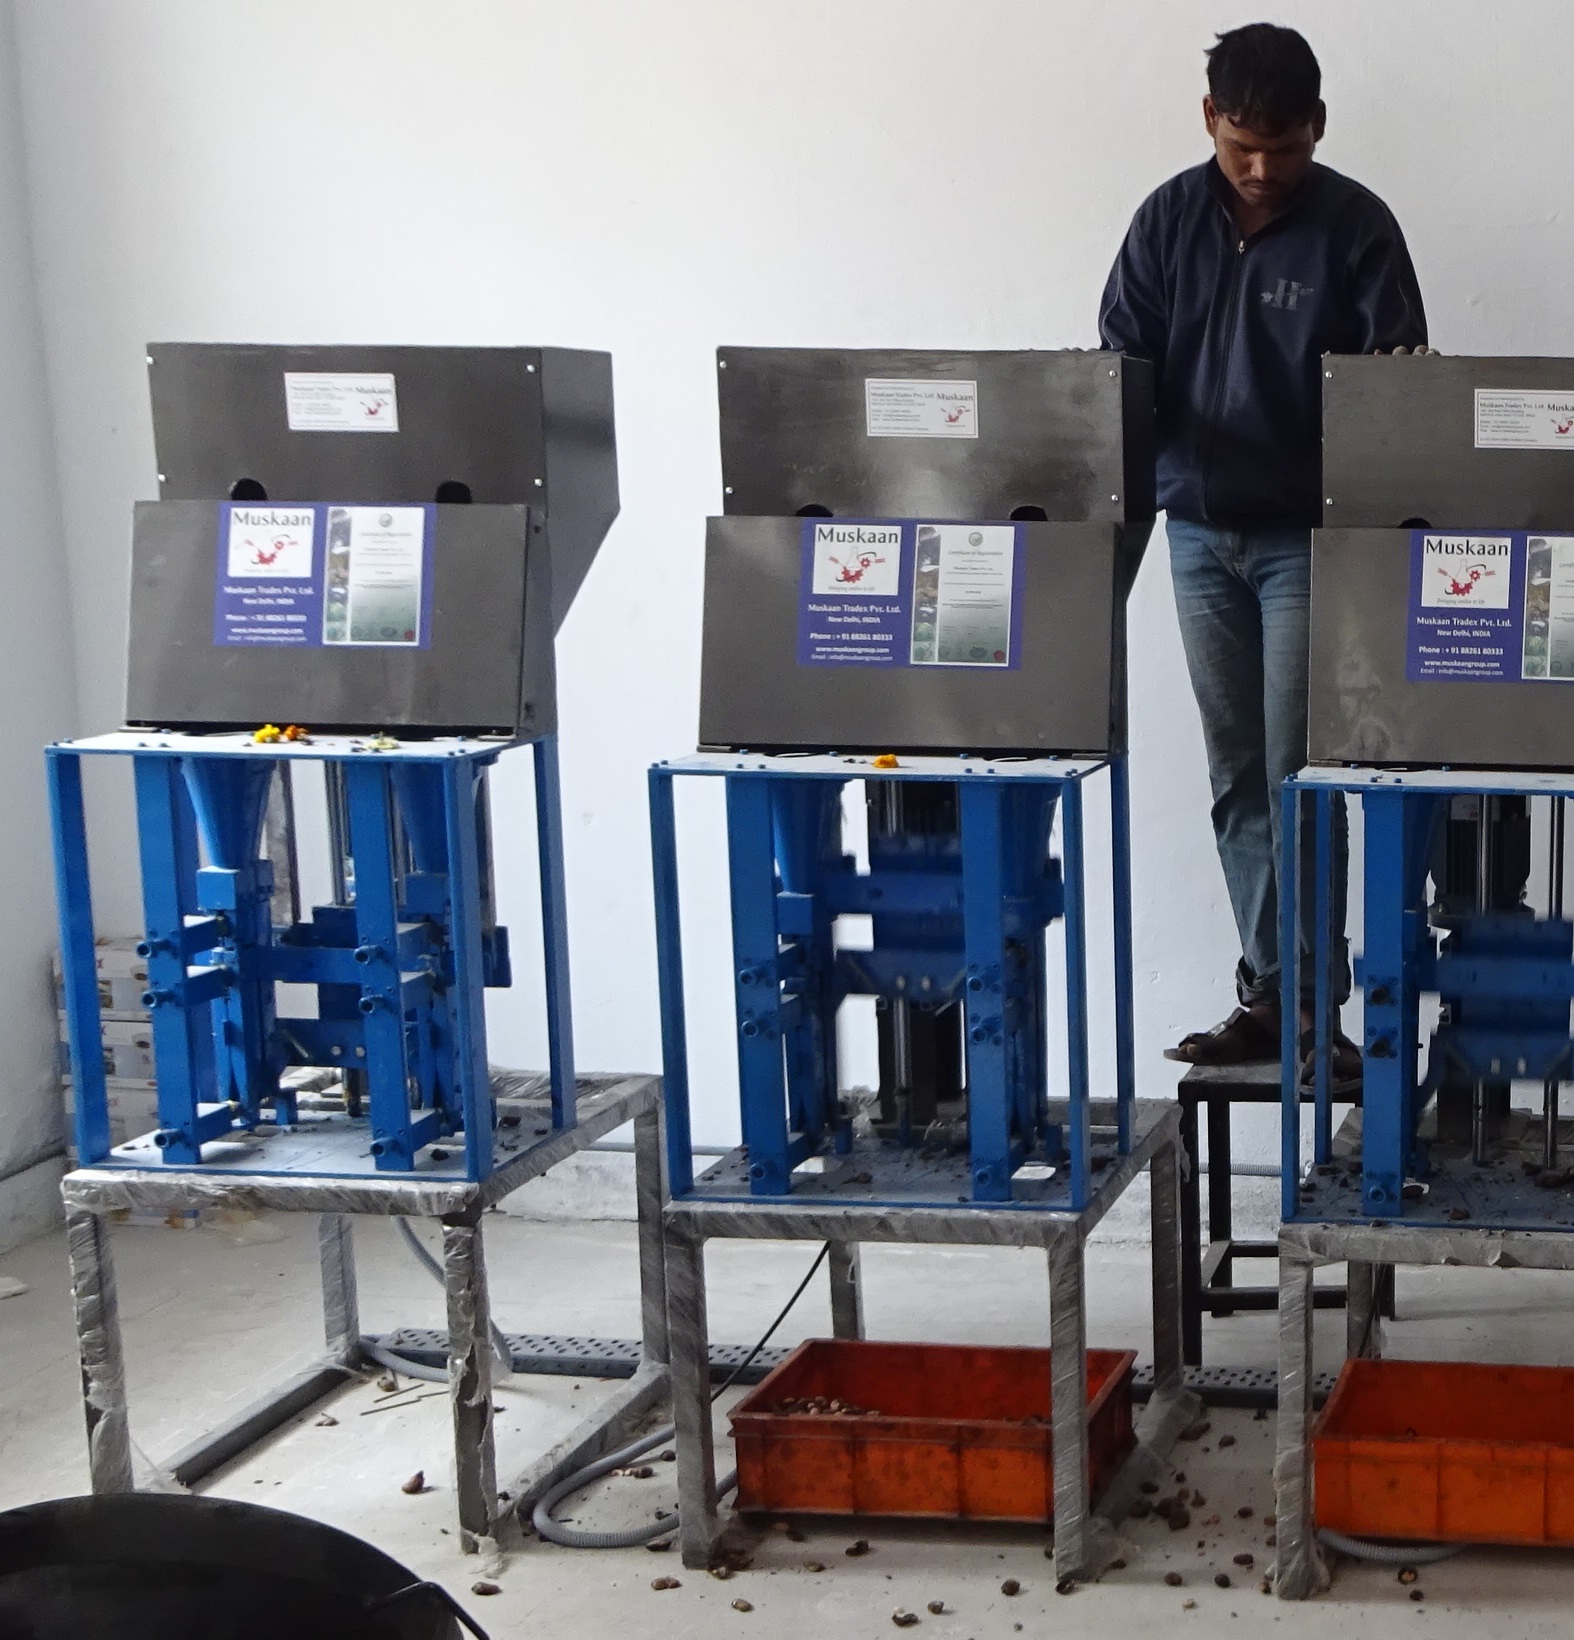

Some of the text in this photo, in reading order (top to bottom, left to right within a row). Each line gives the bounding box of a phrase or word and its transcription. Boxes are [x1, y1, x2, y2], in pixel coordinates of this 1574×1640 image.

[937, 392, 974, 401] Muskaan
[233, 511, 312, 526] Muskaan
[817, 527, 898, 544] Muskaan
[1426, 538, 1508, 556] Muskaan
[808, 604, 841, 612] Muskaan
[843, 604, 868, 612] Tradex
[1417, 616, 1512, 627] Muskaan Tradex Pvt. Ltd.
[1453, 629, 1471, 637] Delhi,
[1425, 660, 1500, 668] www.muskaangroup.com
